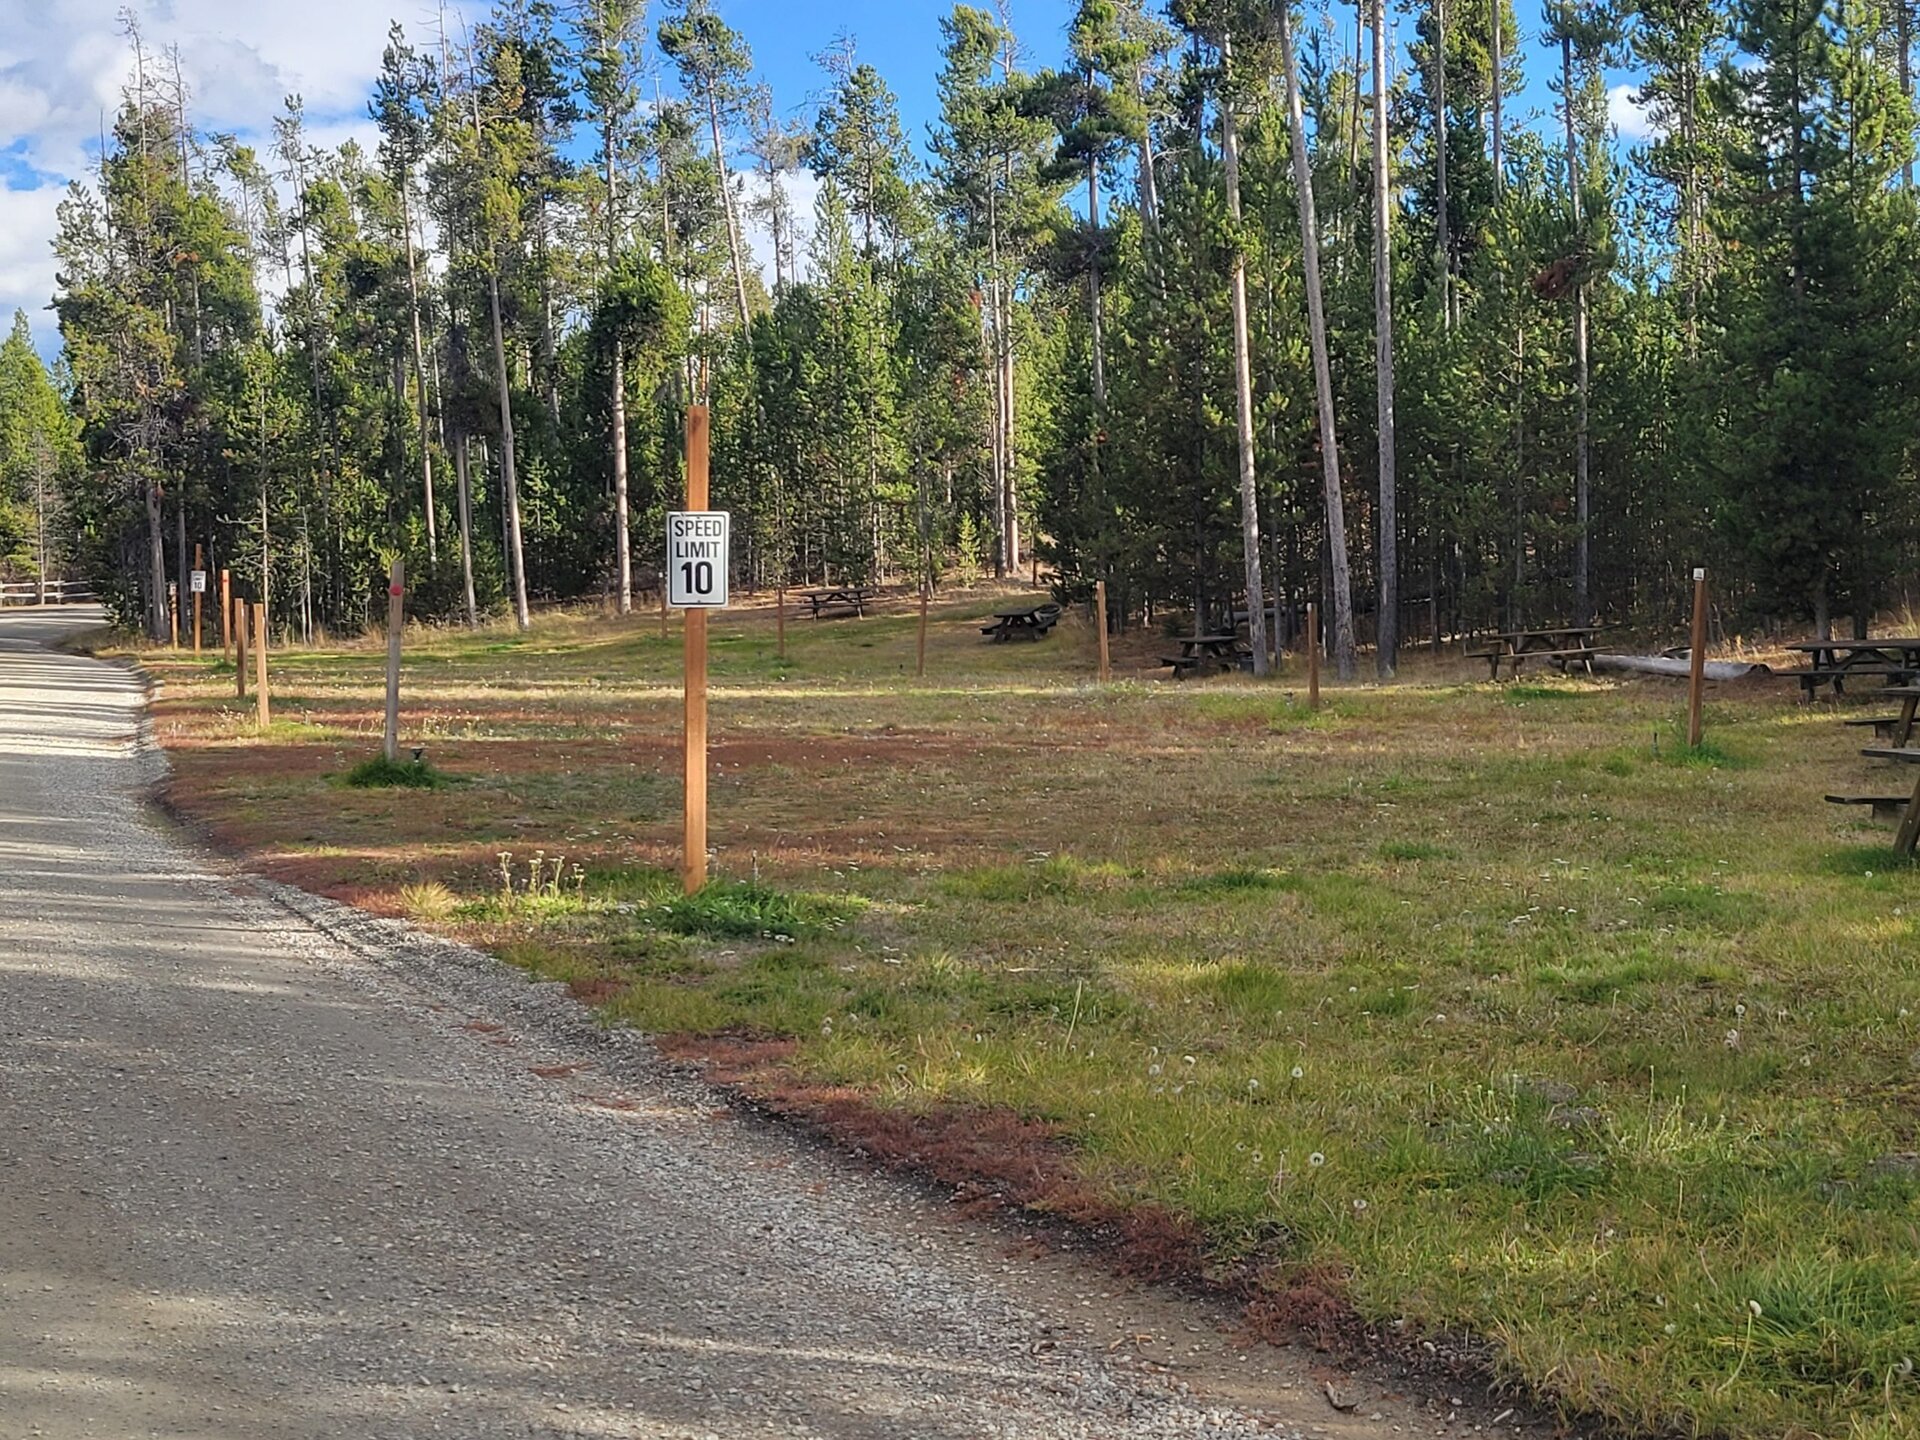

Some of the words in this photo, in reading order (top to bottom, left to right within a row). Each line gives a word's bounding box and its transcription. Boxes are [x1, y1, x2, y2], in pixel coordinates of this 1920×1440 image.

[674, 520, 722, 537] SPEED
[676, 541, 721, 558] LIMIT
[681, 561, 713, 595] 10
